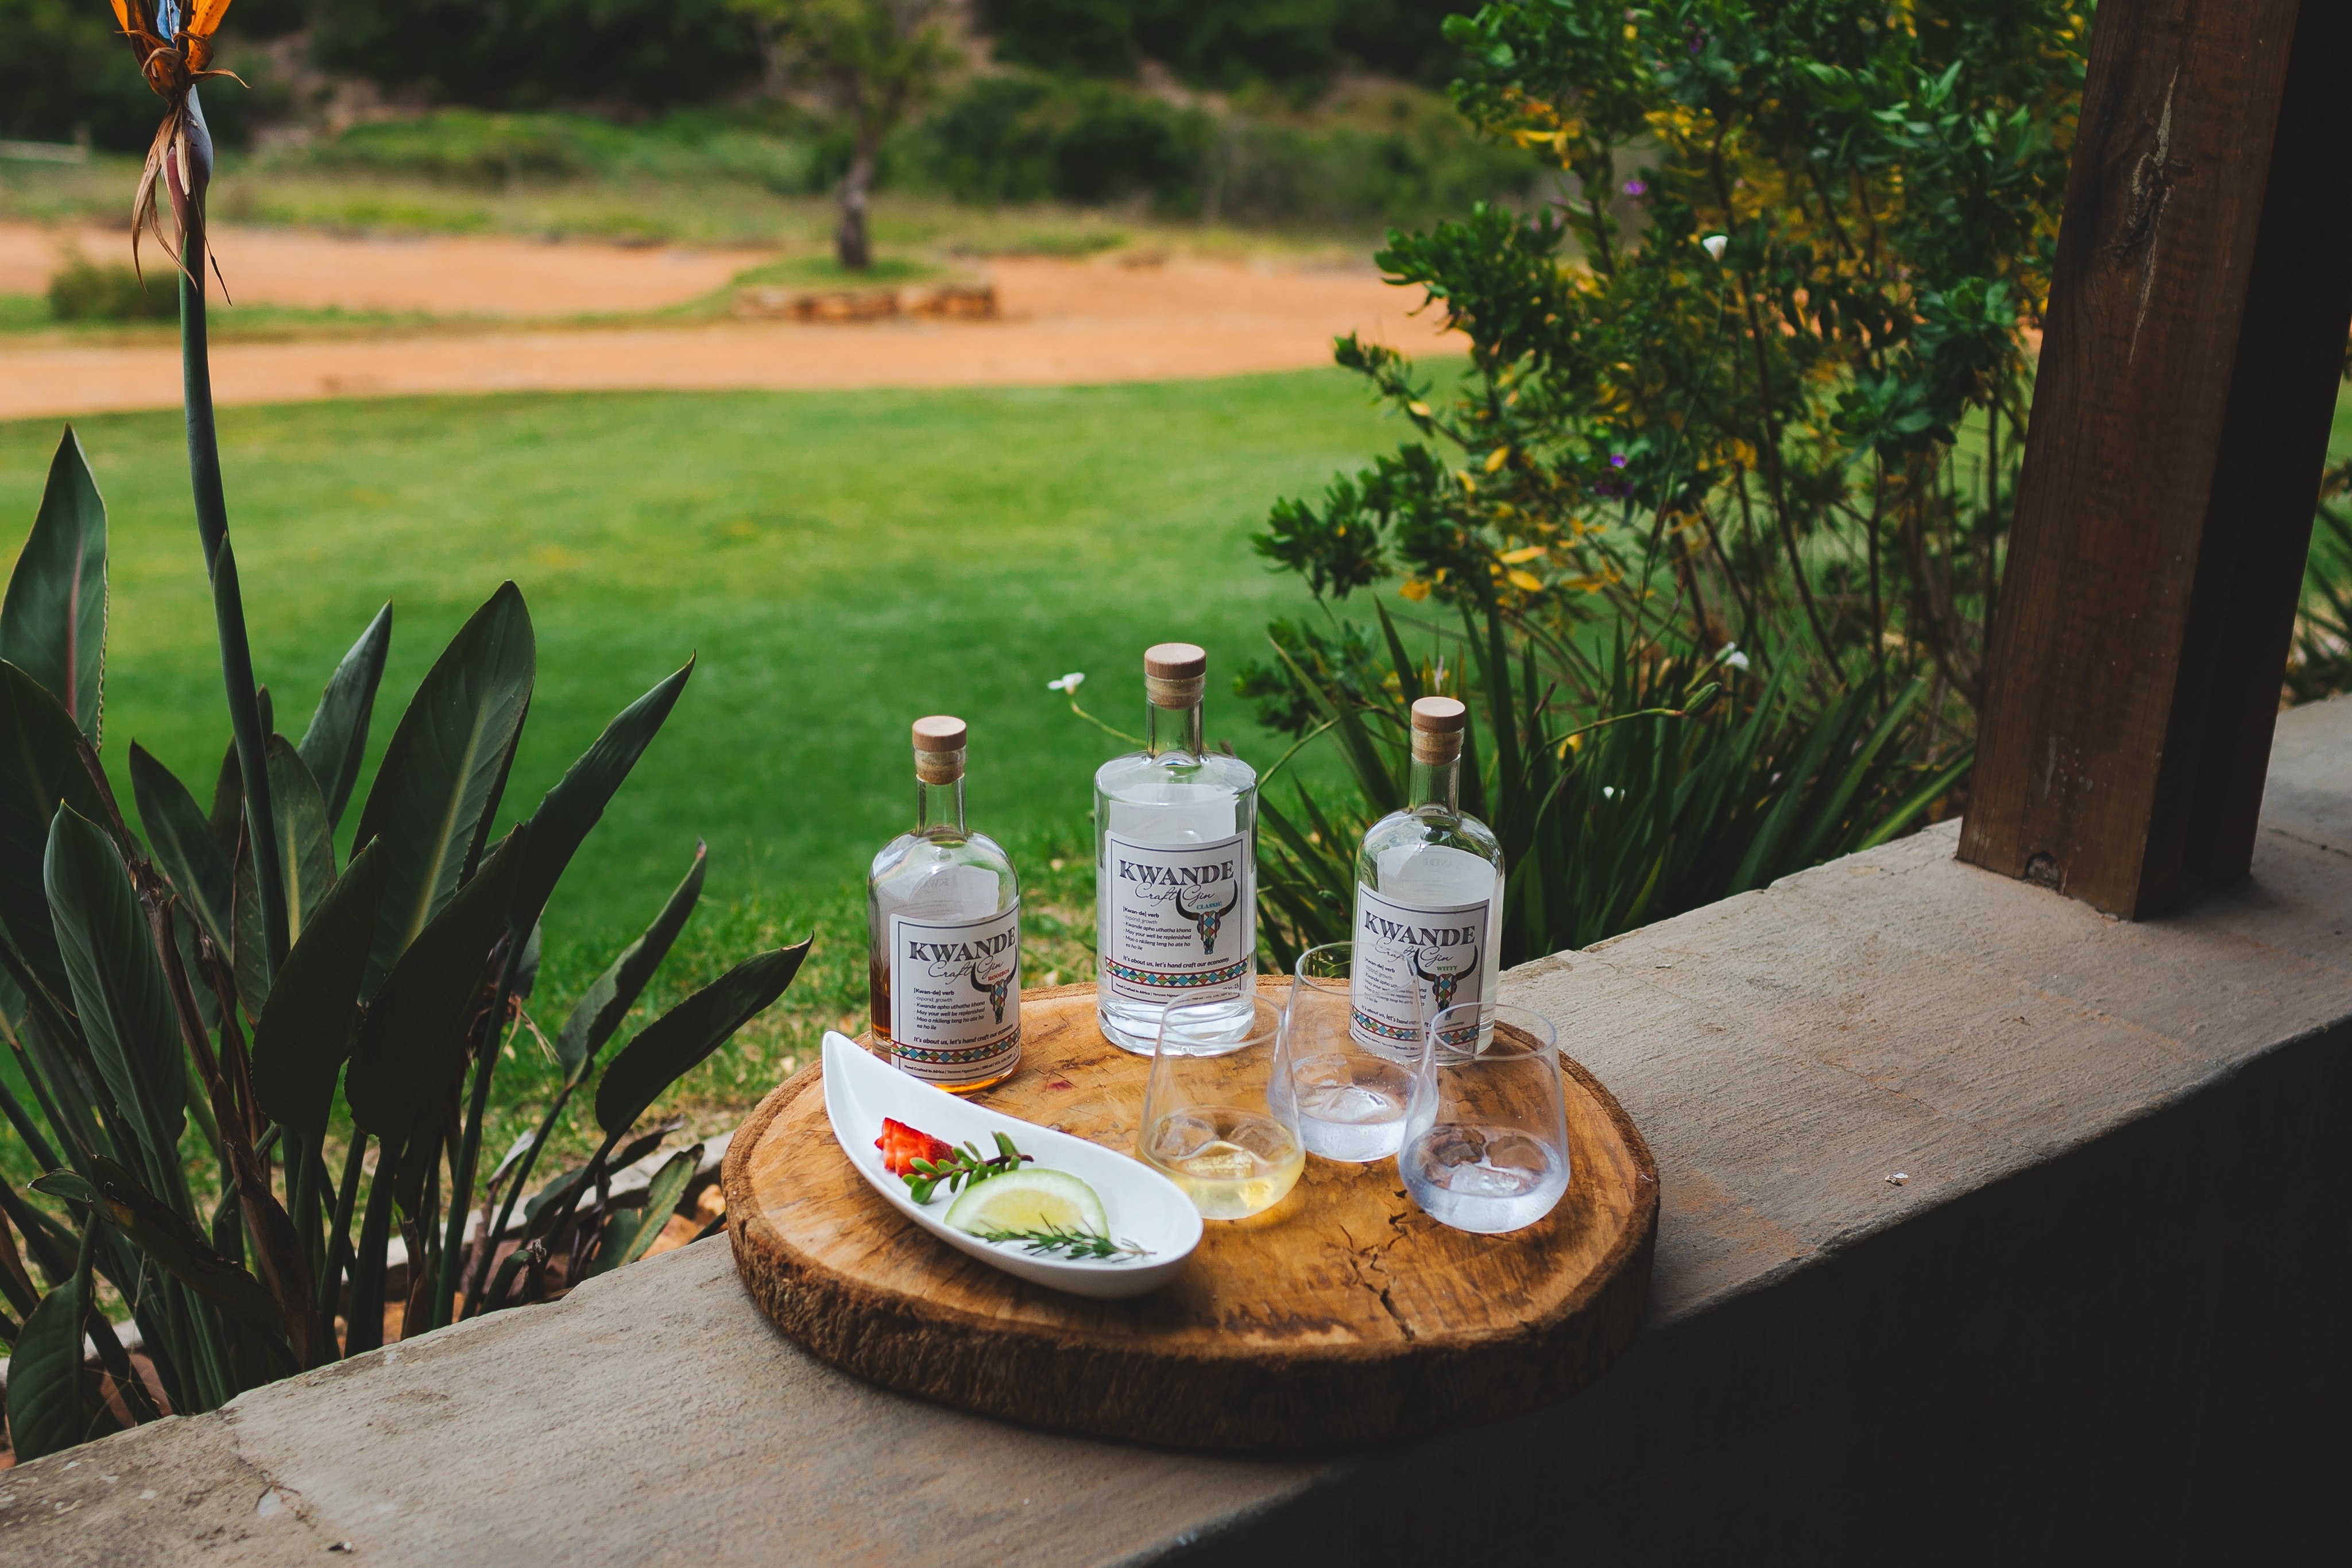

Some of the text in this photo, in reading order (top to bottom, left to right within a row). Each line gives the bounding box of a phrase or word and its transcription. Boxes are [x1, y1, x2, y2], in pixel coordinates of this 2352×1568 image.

[1119, 860, 1235, 885] KWANDE
[1135, 882, 1215, 907] Craft Gin
[1196, 901, 1223, 910] CLASSIC
[1125, 922, 1142, 930] Kwande
[1364, 910, 1475, 946] KWANDE
[909, 926, 1015, 962] KWANDE
[1131, 957, 1145, 965] about
[1207, 957, 1229, 966] economy.
[1420, 946, 1453, 967] Gin
[929, 955, 1004, 985] Craft Gin
[988, 968, 1009, 981] ROOIBOS
[914, 988, 941, 996] [Kwan-de]
[958, 1007, 985, 1016] replenished
[1386, 1014, 1395, 1022] let's
